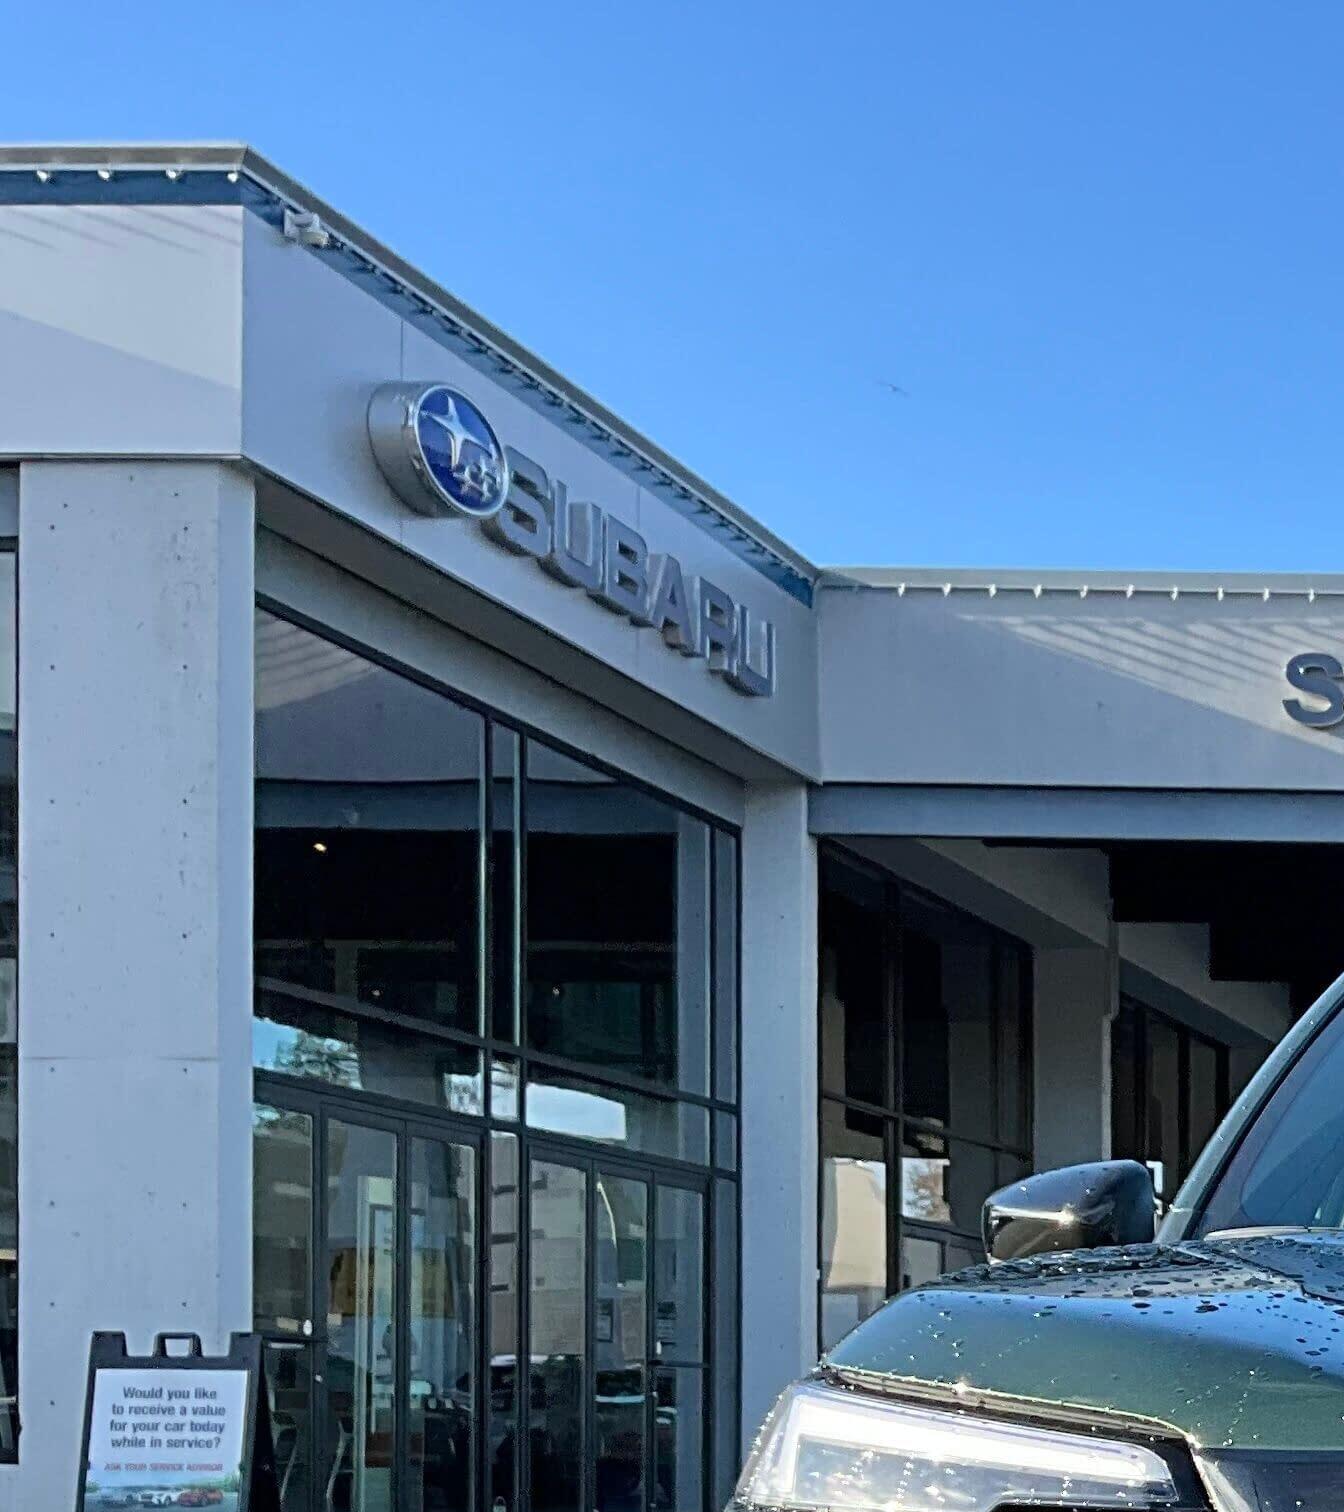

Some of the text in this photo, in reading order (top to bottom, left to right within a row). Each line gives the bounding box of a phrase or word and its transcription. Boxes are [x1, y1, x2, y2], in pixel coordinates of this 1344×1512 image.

[490, 445, 777, 698] SUBARU
[123, 1387, 217, 1401] Would you like
[112, 1403, 226, 1416] to receive a value
[110, 1419, 226, 1434] for your car today
[111, 1436, 221, 1448] while in service?
[149, 1462, 185, 1472] SERVICE
